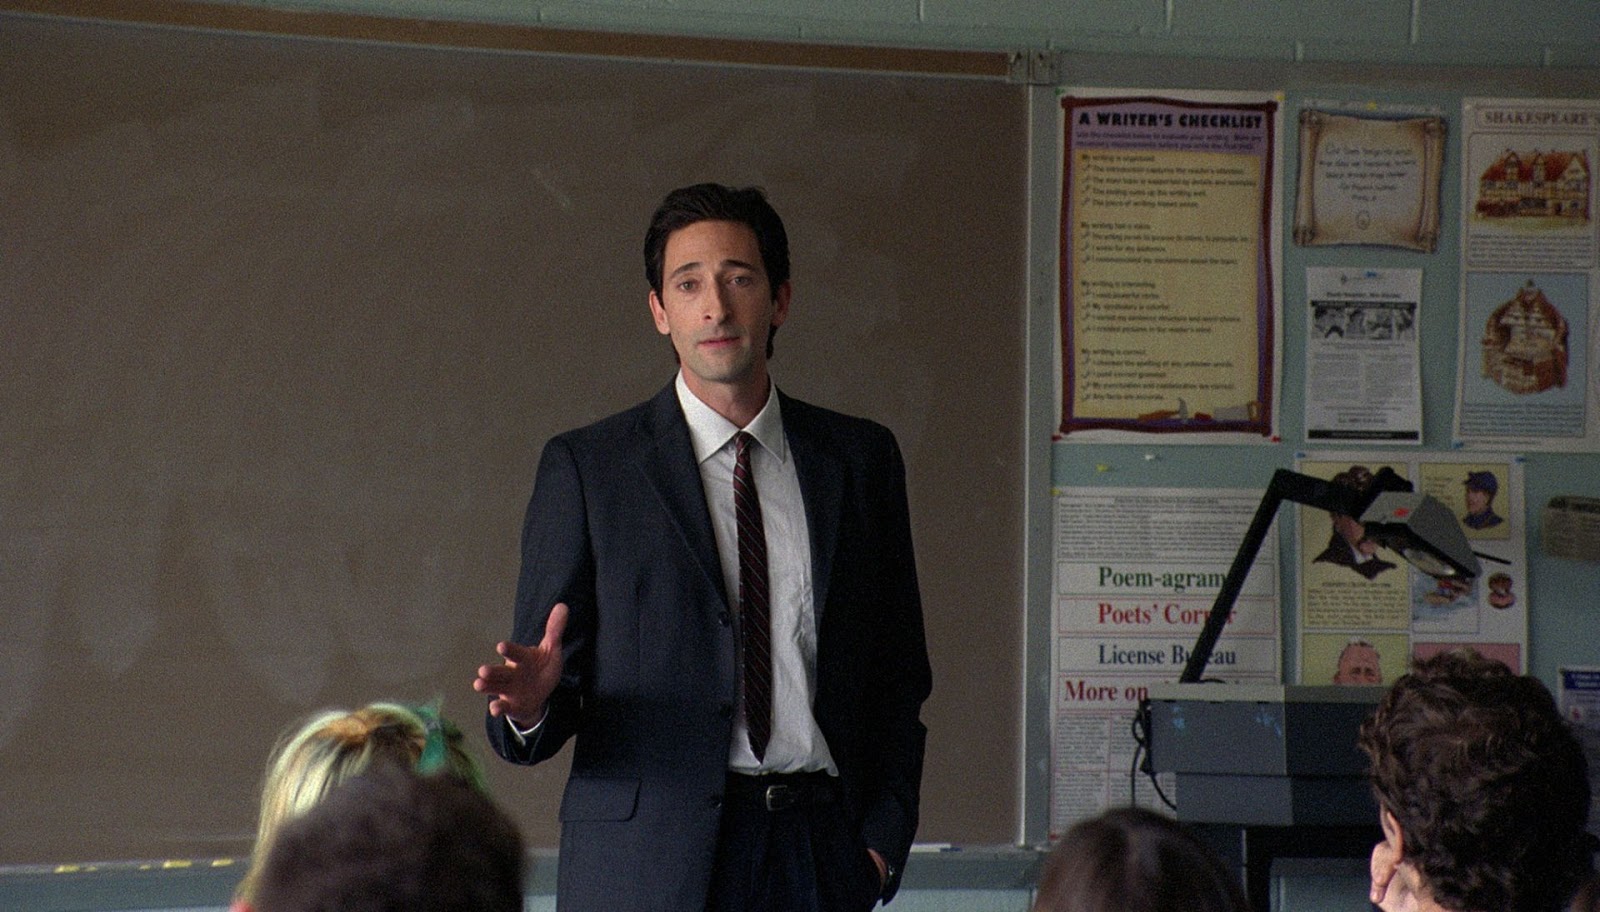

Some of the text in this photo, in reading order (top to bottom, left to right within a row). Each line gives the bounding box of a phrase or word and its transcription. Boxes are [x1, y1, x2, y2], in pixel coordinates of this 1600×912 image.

[1079, 112, 1262, 129] A WRITER'S CHECKLIST
[1099, 602, 1236, 625] Poets' Corr
[1099, 645, 1165, 665] License
[1065, 681, 1148, 702] More on
